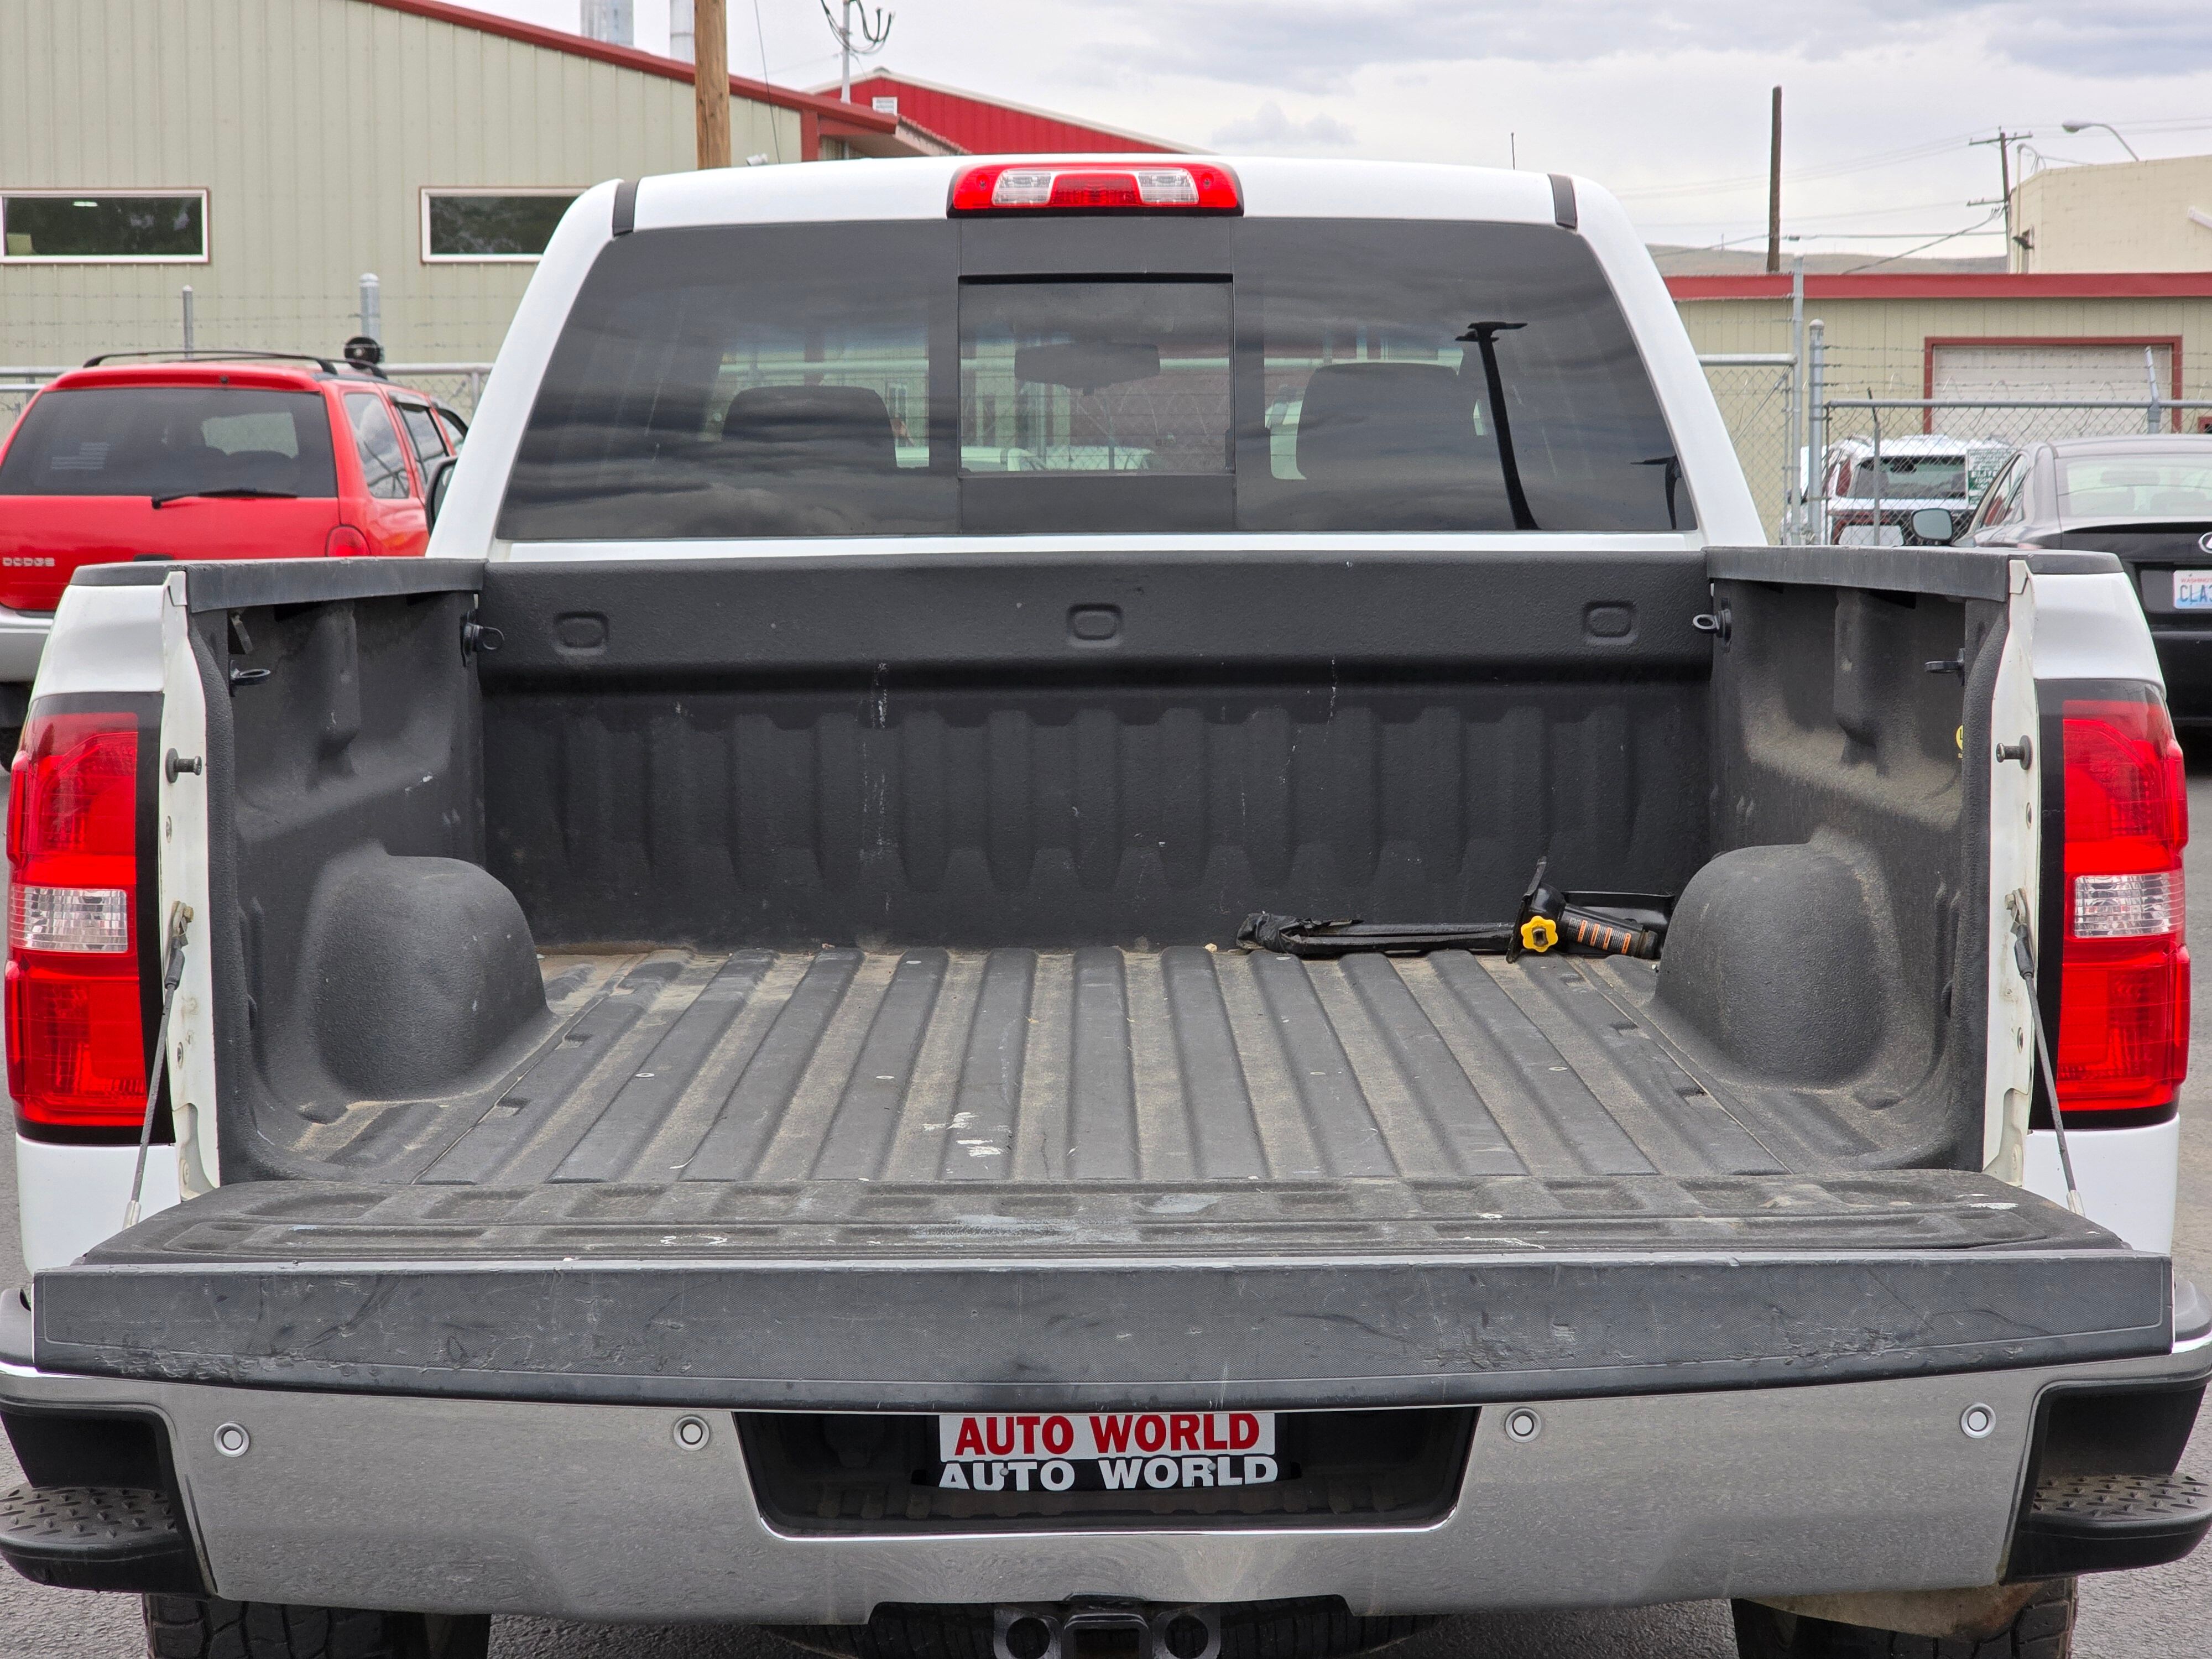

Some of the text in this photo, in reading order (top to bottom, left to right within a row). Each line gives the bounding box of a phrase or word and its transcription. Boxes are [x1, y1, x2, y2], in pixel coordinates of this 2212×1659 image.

[954, 1413, 1260, 1455] AUTO WORLD
[938, 1456, 1279, 1491] AUTO WORLD
